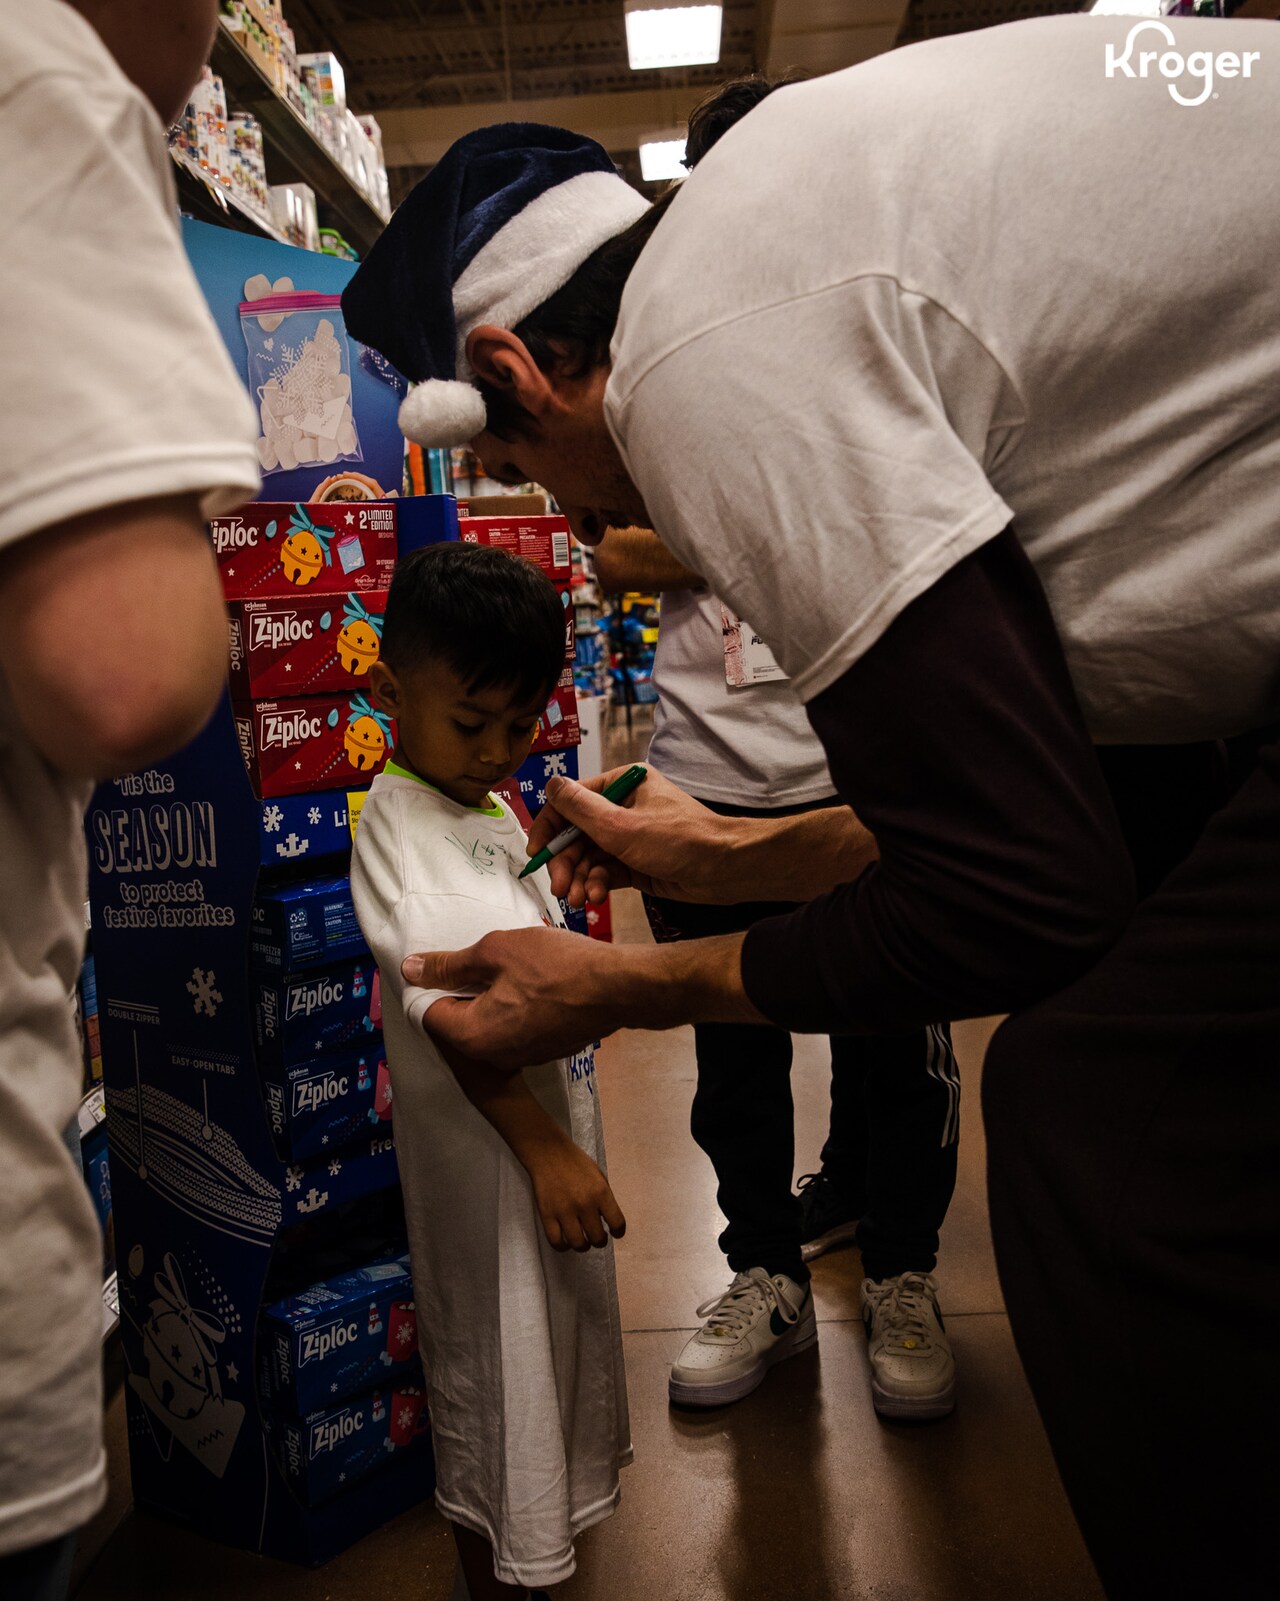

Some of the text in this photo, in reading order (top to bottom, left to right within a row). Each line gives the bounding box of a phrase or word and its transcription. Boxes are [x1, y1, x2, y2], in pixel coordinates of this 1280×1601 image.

[359, 510, 393, 530] 2 LIMITED
[371, 521, 393, 530] EDITION
[211, 521, 258, 553] iploc
[254, 616, 313, 649] Ziploc
[265, 715, 321, 748] Ziploc
[144, 770, 175, 794] the
[92, 801, 217, 874] SEASON
[120, 879, 204, 907] to protect
[104, 903, 235, 928] festive favorites
[260, 943, 281, 957] FREEZER
[107, 1007, 160, 1025] DOUBLE ZIPPER
[261, 990, 276, 1038] Ziploc
[291, 983, 343, 1016] Ziploc
[171, 1055, 235, 1075] EASY-OPEN TABS
[267, 1086, 283, 1135] Ziploc
[297, 1077, 348, 1111] Ziploc
[370, 1139, 395, 1156] Fre
[303, 1323, 358, 1361] Ziploc
[276, 1337, 290, 1385] Ziploc
[314, 1411, 364, 1451] Ziploc
[285, 1429, 300, 1476] Ziploc
